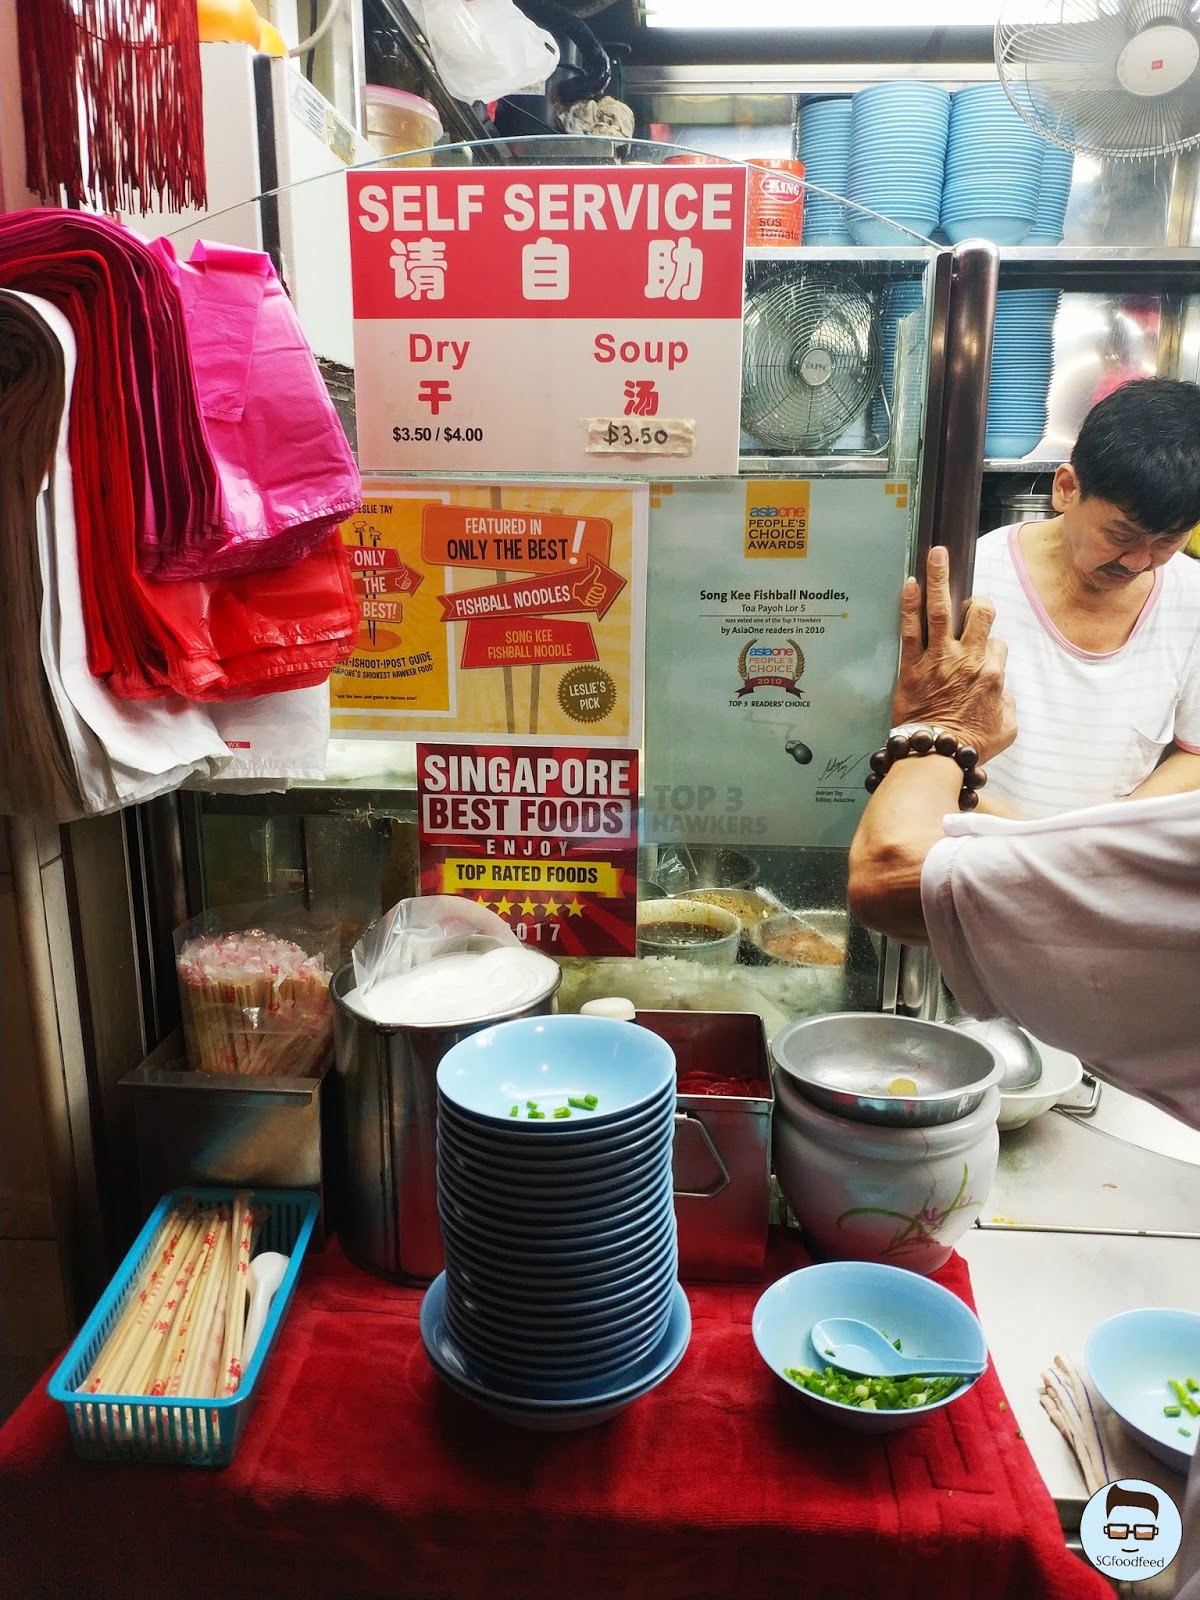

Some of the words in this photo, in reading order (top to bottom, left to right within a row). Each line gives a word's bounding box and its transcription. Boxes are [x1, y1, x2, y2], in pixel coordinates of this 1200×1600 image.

[358, 185, 485, 232] SELF
[504, 183, 733, 232] SERVICE
[760, 228, 799, 241] Tomato
[409, 334, 470, 370] Dry
[594, 334, 689, 369] Soup
[418, 380, 452, 416] 干
[624, 380, 659, 416] 汤
[392, 427, 432, 443] $3.50
[444, 427, 483, 443] $4.00
[604, 422, 669, 446] $3.50
[380, 504, 393, 514] TAY
[750, 506, 806, 517] asiaone
[465, 518, 526, 535] FEATURED
[530, 519, 542, 536] IN
[748, 519, 806, 528] PEOPLE'S
[748, 529, 806, 539] CHOICE
[448, 538, 488, 560] ONLY
[493, 538, 522, 560] THE
[748, 540, 805, 549] AWARDS
[354, 550, 386, 567] ONLY
[363, 577, 387, 594] THE
[456, 594, 512, 617] FISHBALL
[514, 586, 571, 609] NOODLES
[700, 590, 728, 603] Song
[730, 590, 751, 600] Kee
[754, 589, 796, 600] Fishball
[800, 589, 849, 602] Noodles,
[363, 602, 397, 620] BEST!
[742, 604, 756, 612] Toa
[758, 604, 783, 614] Payoh
[786, 604, 798, 612] Lor
[801, 604, 806, 612] 5
[506, 630, 533, 644] SONG
[535, 630, 553, 643] KEE
[721, 626, 730, 636] by
[732, 626, 764, 634] AsiaOne
[765, 626, 794, 634] readers
[796, 626, 803, 634] in
[409, 651, 433, 666] GUIDE
[488, 646, 532, 660] FISHBALL
[534, 644, 573, 658] NOODLE
[749, 646, 794, 657] asiaone
[331, 666, 361, 678] GAPORE'S
[392, 668, 417, 679] HAWKER
[749, 665, 792, 673] CHOICE
[569, 680, 607, 697] LESLIE'S
[580, 698, 601, 711] PICK
[424, 754, 631, 796] SINGAPORE
[653, 784, 717, 812] TOP
[726, 786, 743, 812] 3
[428, 798, 510, 831] BEST
[520, 800, 624, 834] FOODS
[652, 814, 768, 835] HAWKERS
[486, 839, 568, 857] ENJOY
[456, 864, 487, 881] TOP
[492, 865, 541, 882] RATED
[547, 866, 598, 883] FOODS
[509, 922, 560, 942] 017
